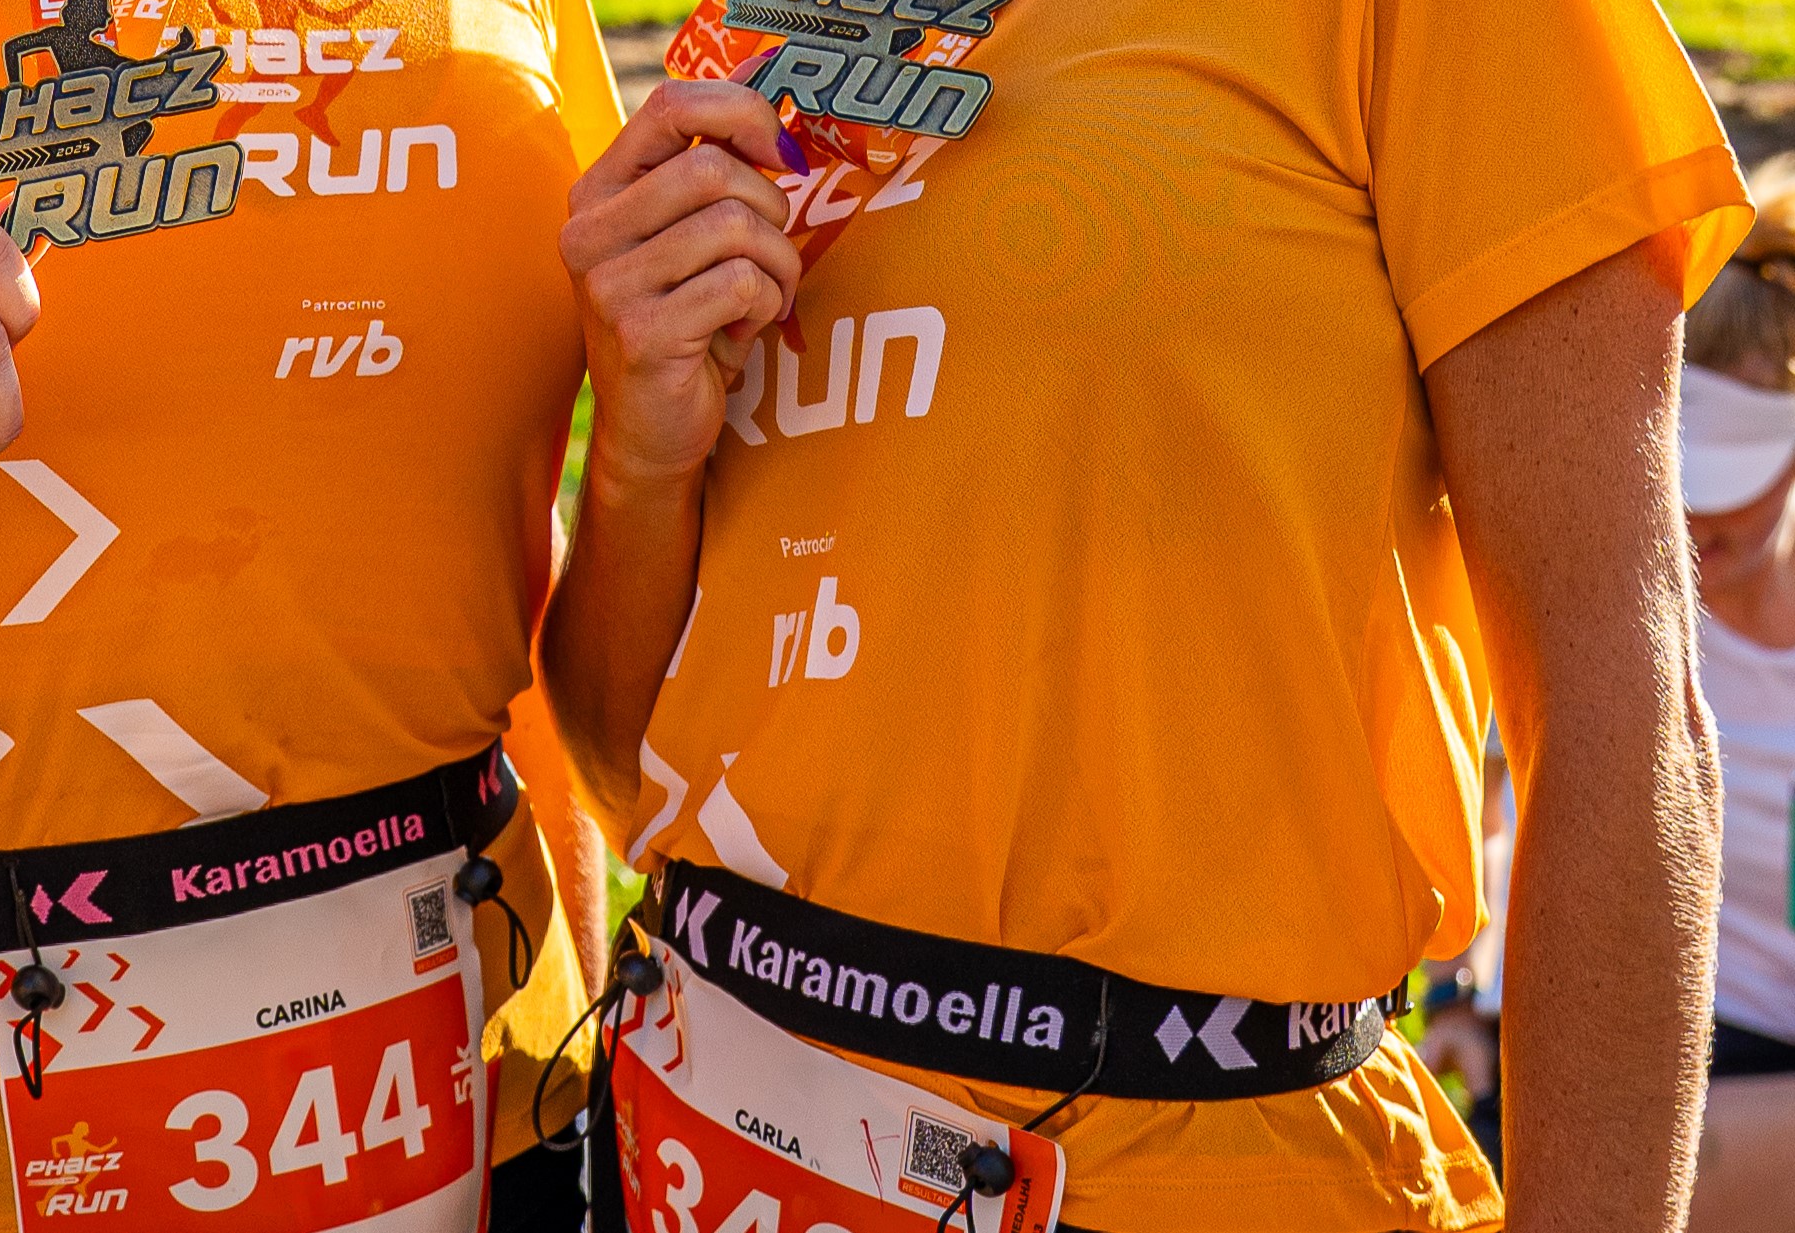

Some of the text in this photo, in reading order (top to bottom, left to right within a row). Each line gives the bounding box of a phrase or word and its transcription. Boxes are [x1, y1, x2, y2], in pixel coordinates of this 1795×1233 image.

[55, 141, 91, 158] 2025
[302, 299, 386, 312] Patrocinio
[274, 319, 404, 379] rvb
[170, 813, 427, 903] Karamoella
[255, 989, 347, 1030] CARINA
[728, 918, 1065, 1051] Karamoella
[164, 1038, 433, 1213] 344
[734, 1108, 803, 1160] CARLA
[1011, 1177, 1032, 1233] EDALHA
